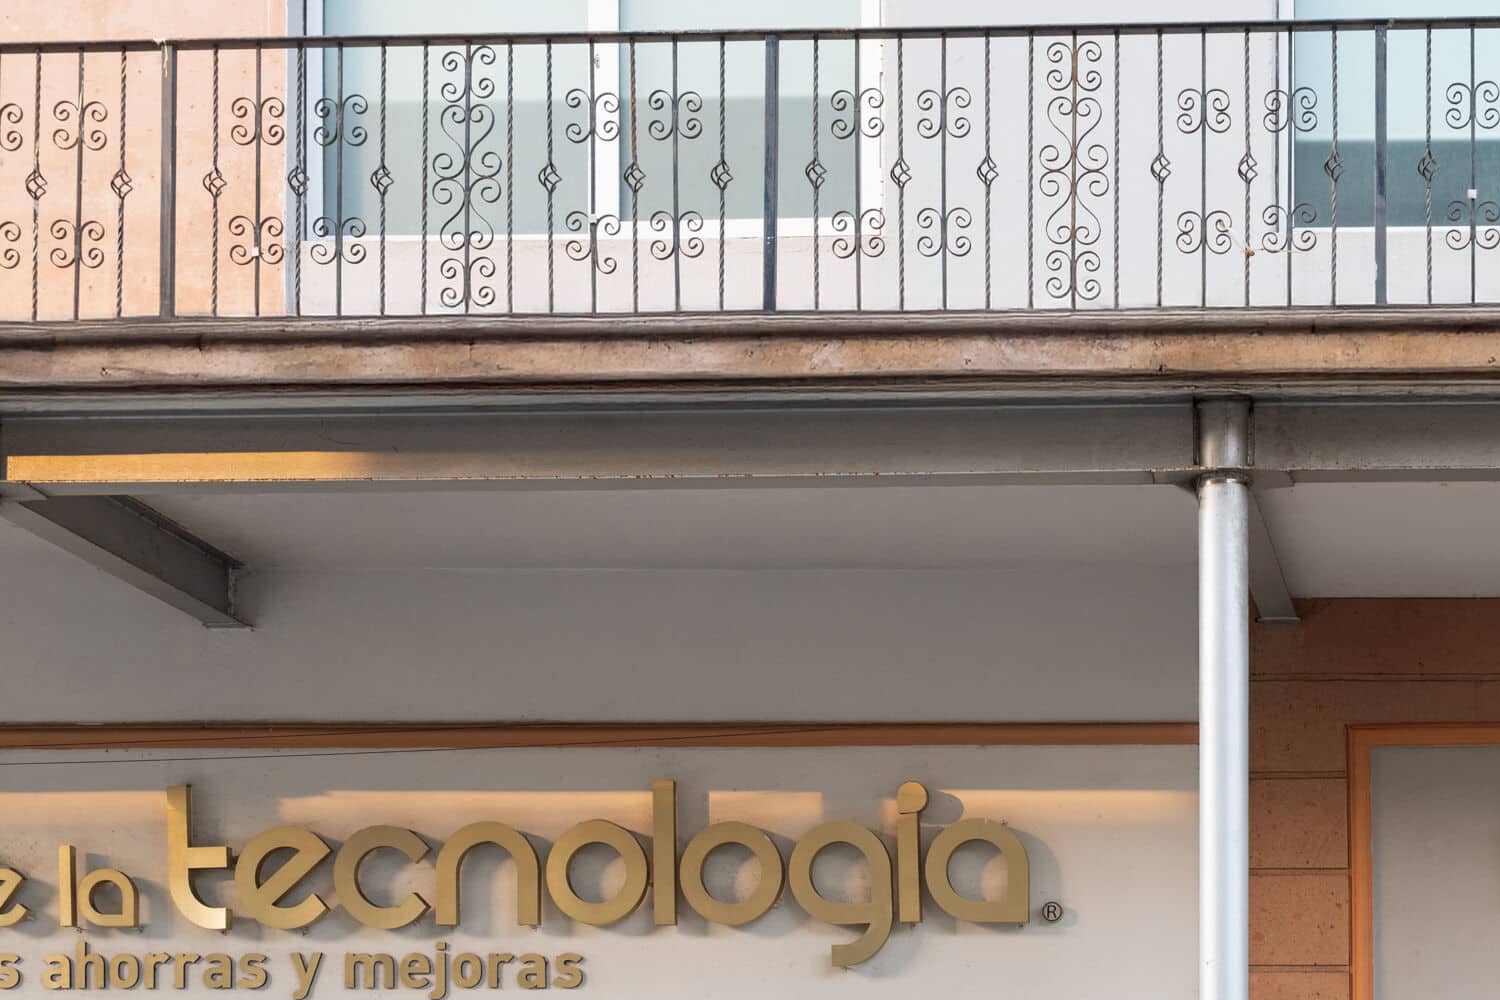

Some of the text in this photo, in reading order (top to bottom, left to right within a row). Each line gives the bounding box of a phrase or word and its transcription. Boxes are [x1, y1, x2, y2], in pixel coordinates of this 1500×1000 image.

[58, 843, 140, 928] la
[42, 941, 270, 990] ahorras
[290, 951, 324, 1000] y
[345, 941, 585, 1000] mejoras
